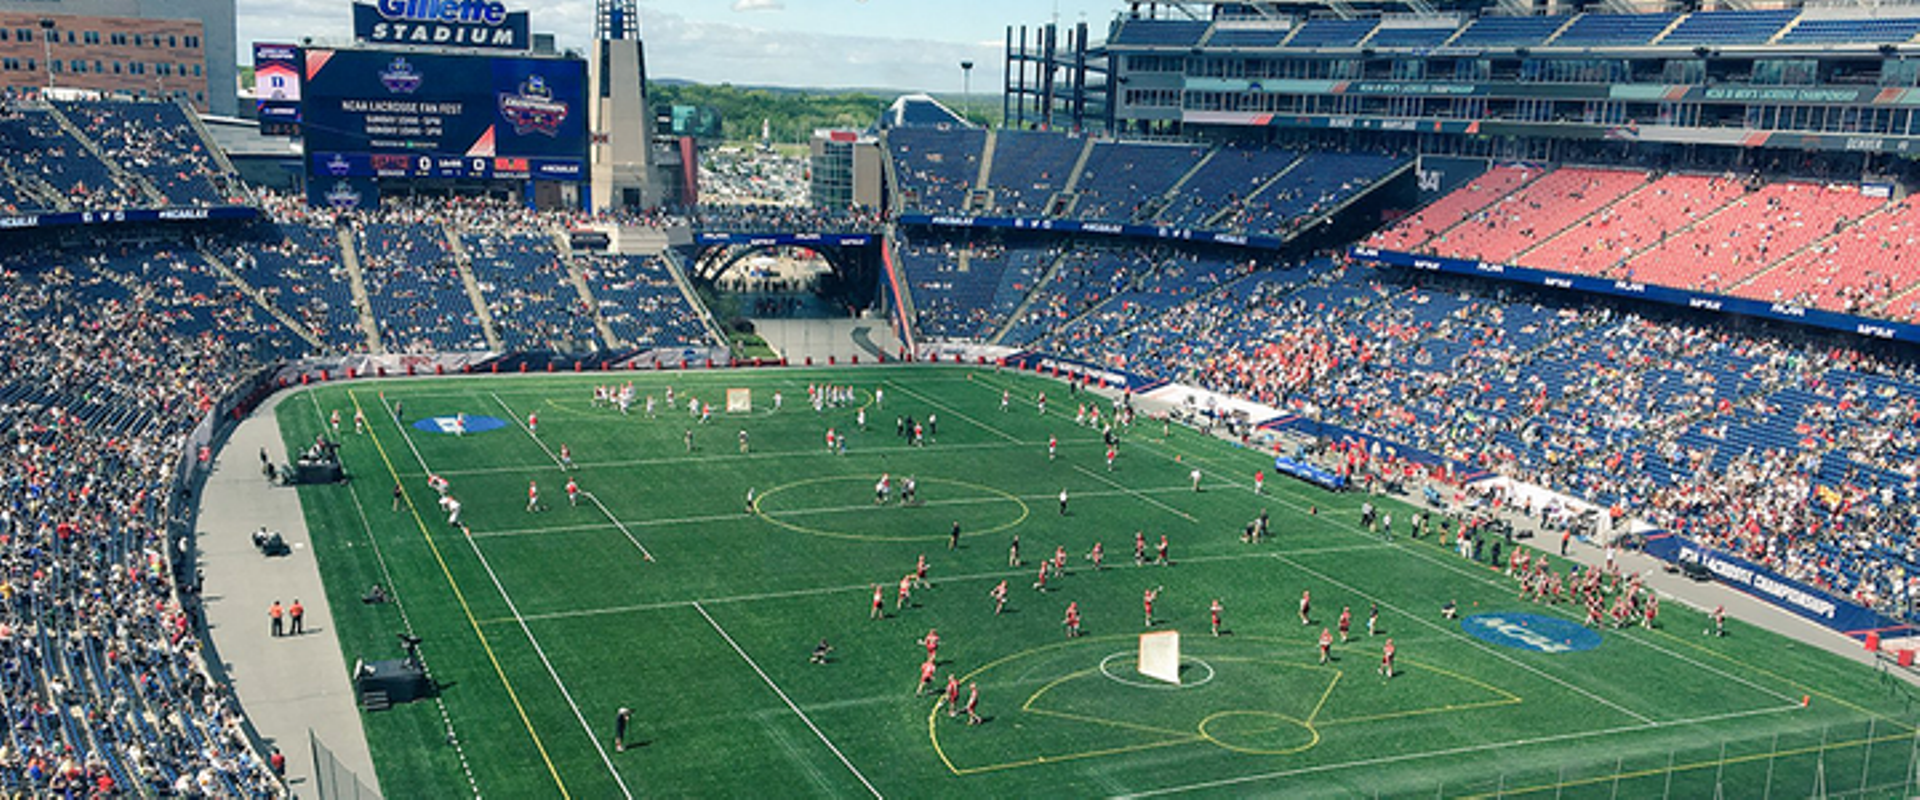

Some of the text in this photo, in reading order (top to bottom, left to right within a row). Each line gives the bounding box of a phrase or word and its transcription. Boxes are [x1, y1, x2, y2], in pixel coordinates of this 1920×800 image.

[372, 23, 514, 45] STADIUM
[342, 101, 462, 115] NCAA LACROSSE FAN FEST
[419, 156, 432, 171] 0
[473, 159, 485, 171] 0
